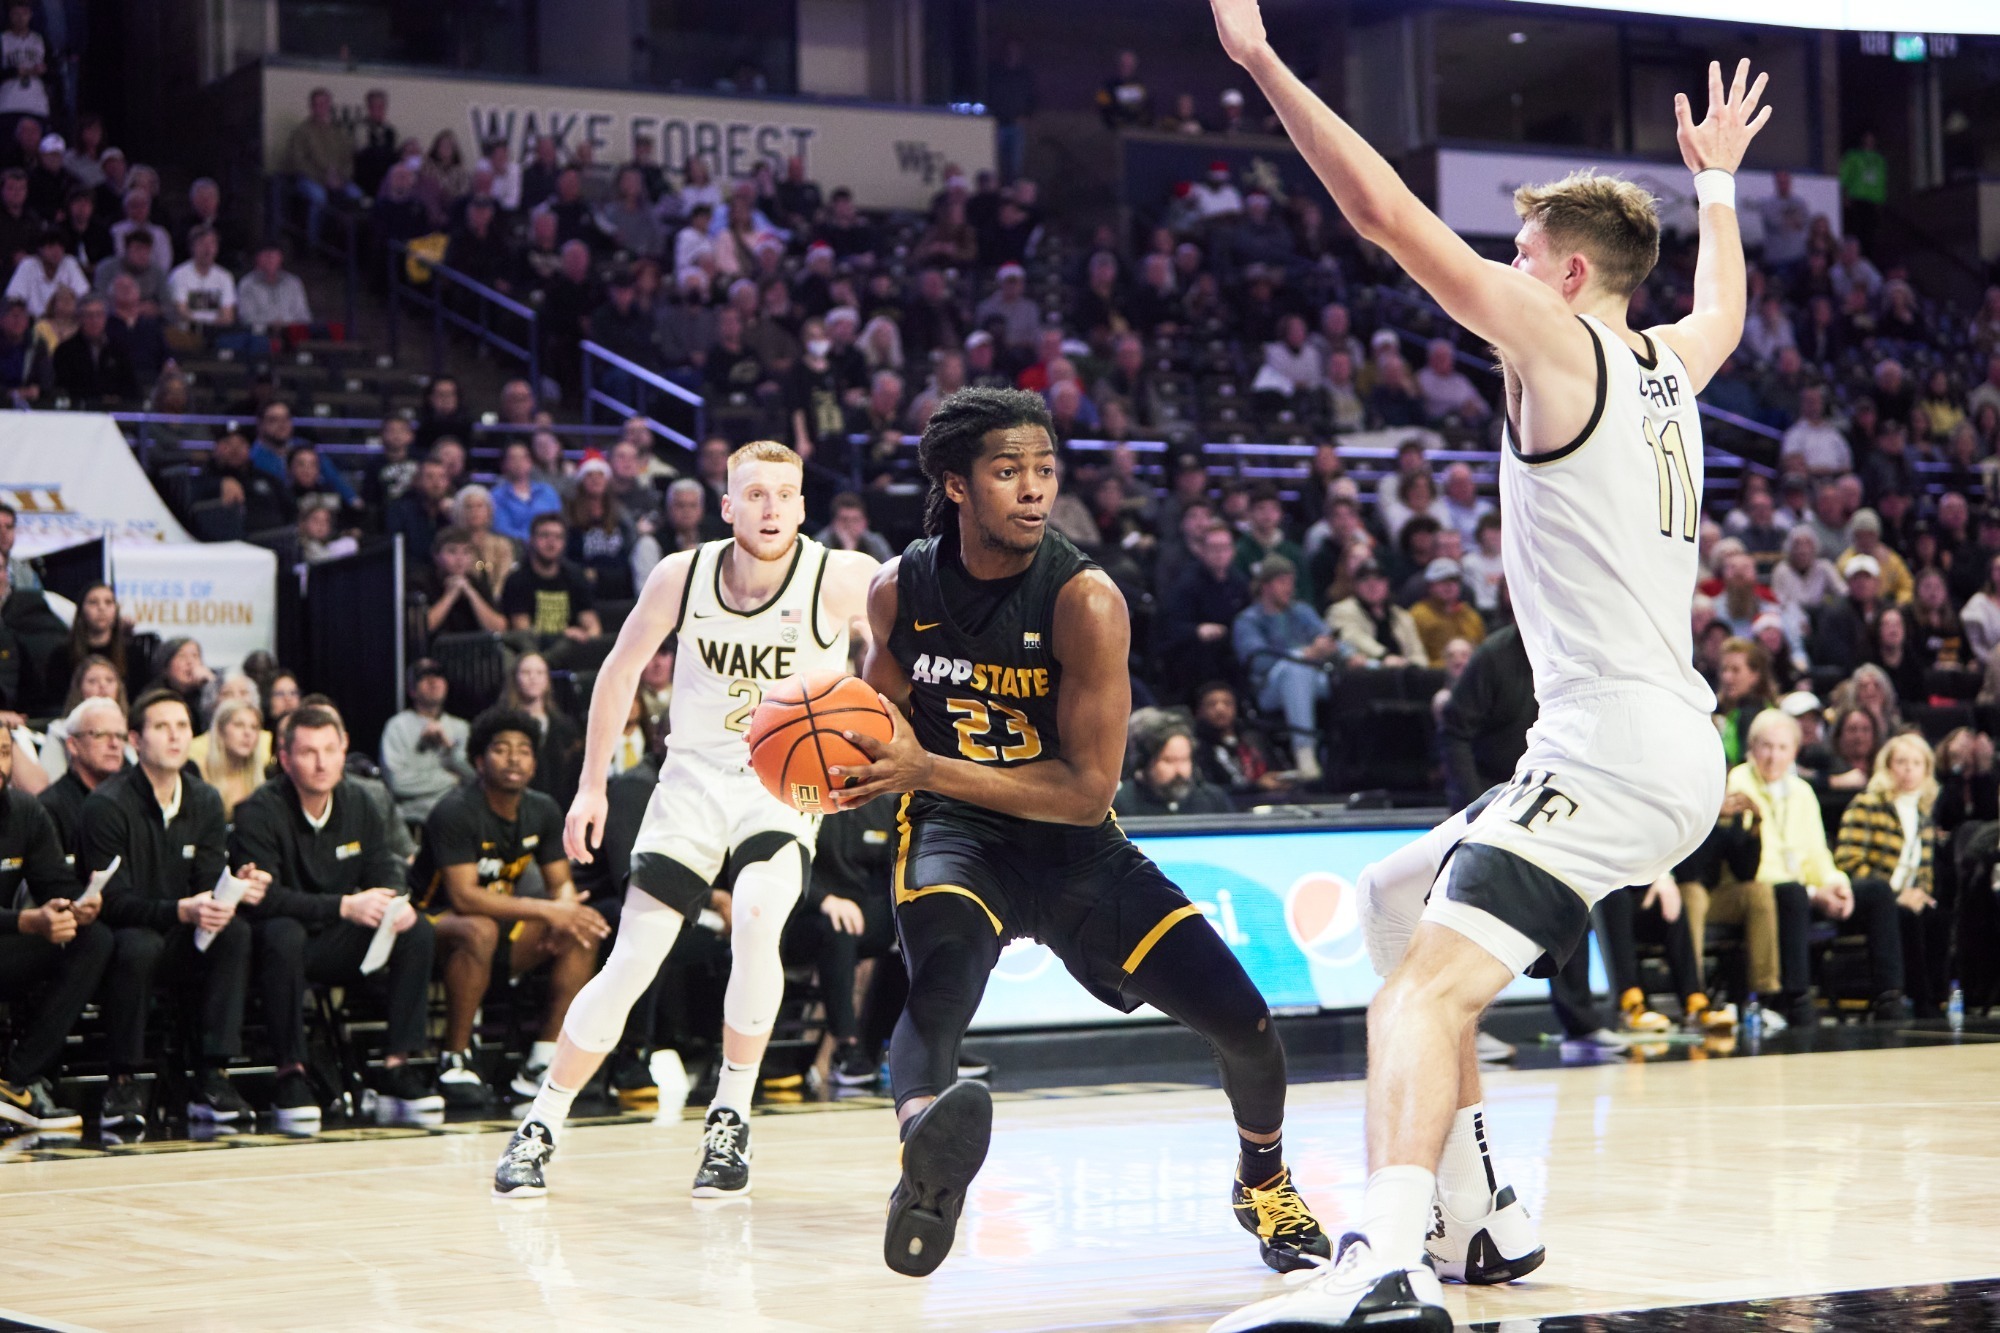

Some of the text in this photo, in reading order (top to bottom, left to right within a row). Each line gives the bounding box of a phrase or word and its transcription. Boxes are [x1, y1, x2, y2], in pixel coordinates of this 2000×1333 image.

[470, 107, 816, 177] WAKE FOREST
[1642, 416, 1698, 543] 11
[115, 580, 214, 598] FFICES OF
[132, 601, 255, 625] WELBORN
[697, 637, 797, 680] WAKE
[725, 679, 762, 733] 2
[946, 698, 1042, 762] 23
